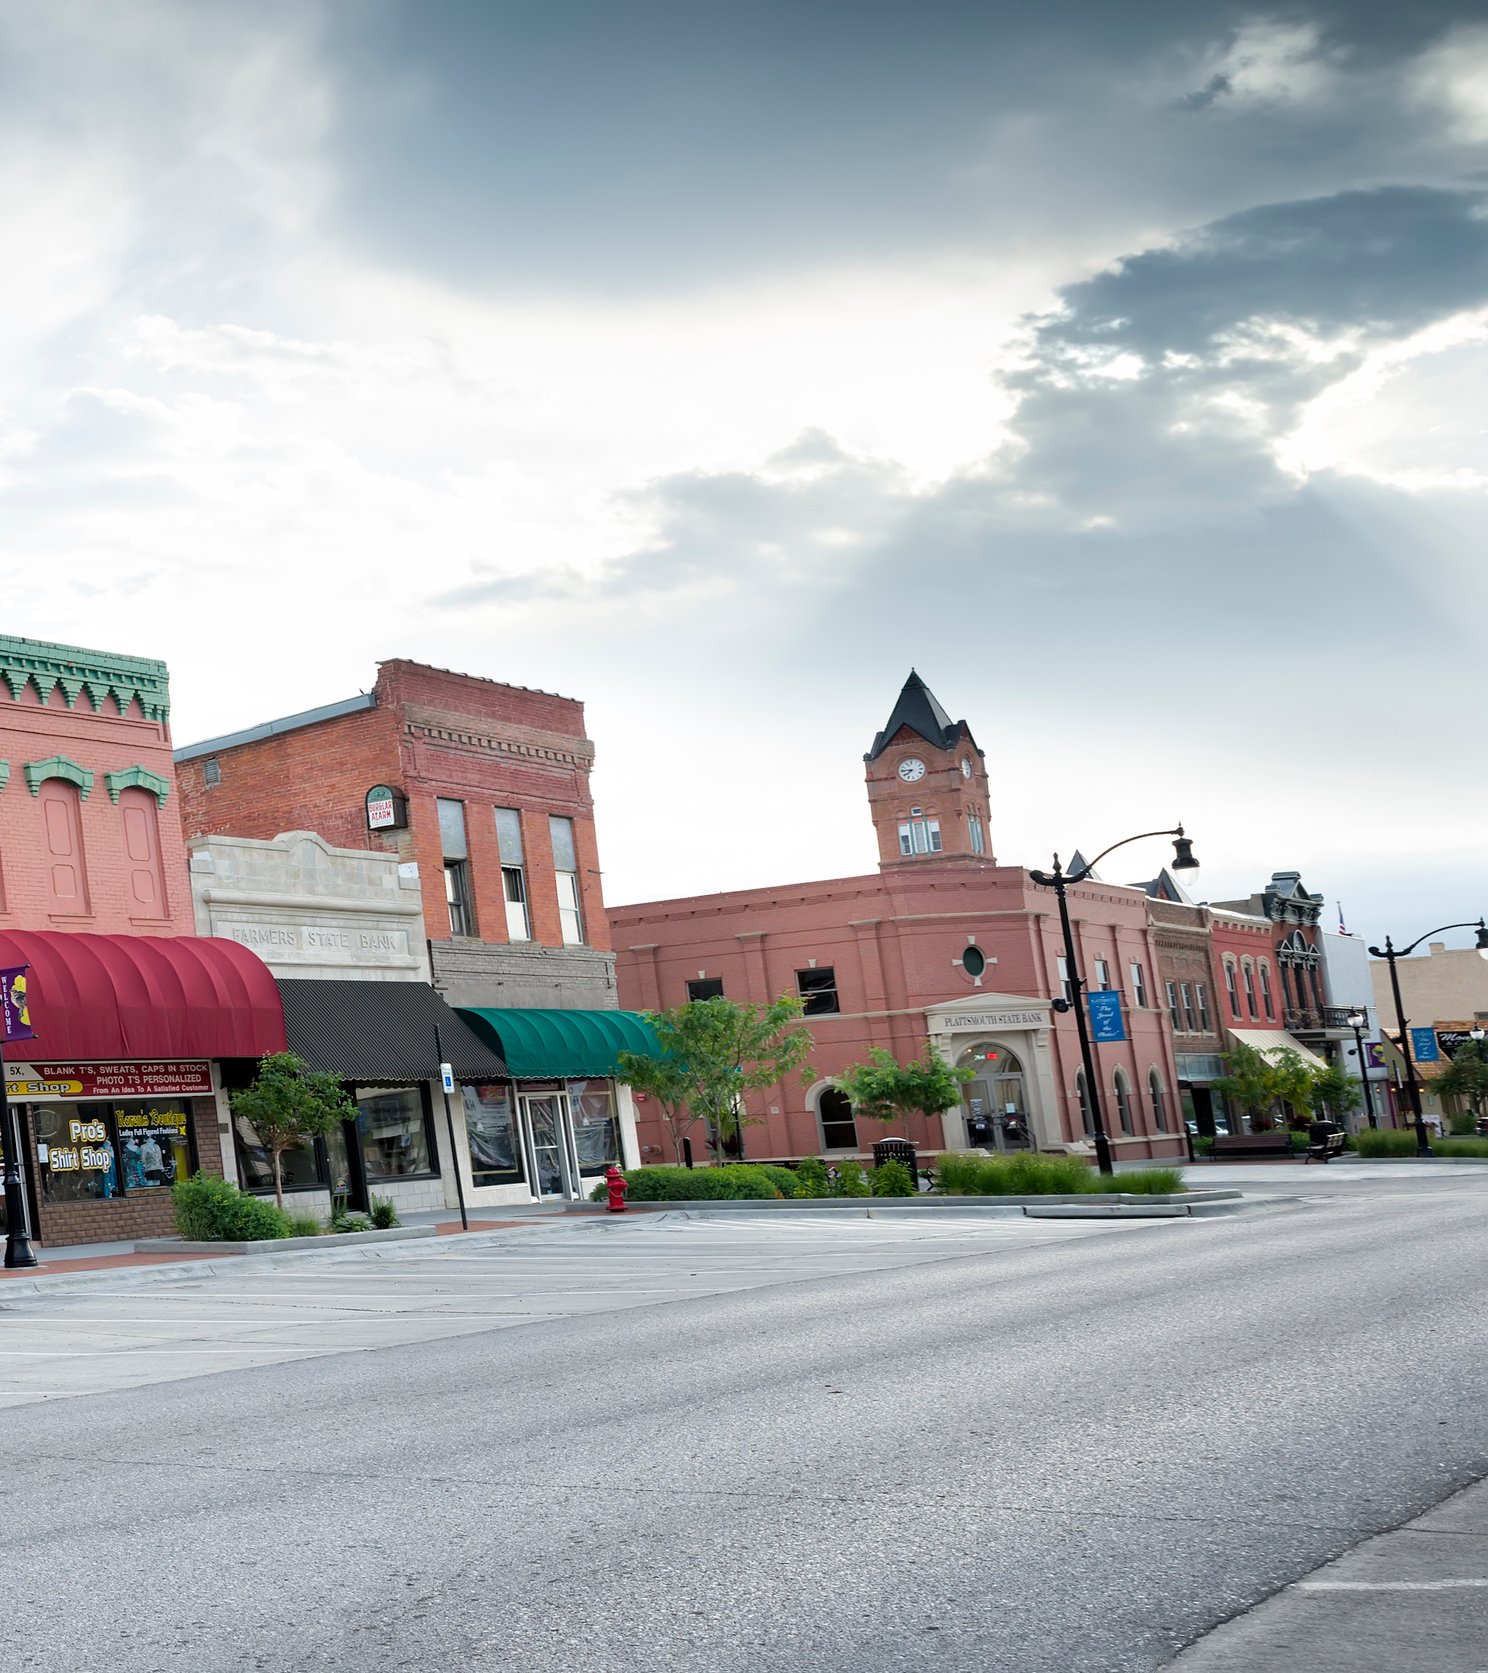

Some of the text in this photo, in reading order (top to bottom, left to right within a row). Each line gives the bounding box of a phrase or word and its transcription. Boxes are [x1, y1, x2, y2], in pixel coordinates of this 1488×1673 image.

[369, 801, 392, 812] BURGLAR
[372, 810, 391, 821] ALARM
[233, 928, 396, 949] FARMERS STATE BANK
[1, 976, 12, 1034] WELCOME
[945, 1013, 1042, 1027] PLATTSMOUTH STATE BANK
[44, 1066, 75, 1075] BLANK
[141, 1065, 165, 1073] CAPS
[168, 1064, 177, 1072] IN
[180, 1064, 208, 1072] STOCK
[97, 1074, 202, 1085] PHOTO T'S PERSONALIZED
[27, 1082, 71, 1094] Shop
[69, 1120, 106, 1142] Pro's
[119, 1129, 133, 1137] Ladies
[143, 1128, 159, 1136] Figured
[159, 1127, 178, 1135] Fashions
[50, 1147, 111, 1172] Shirt Shop
